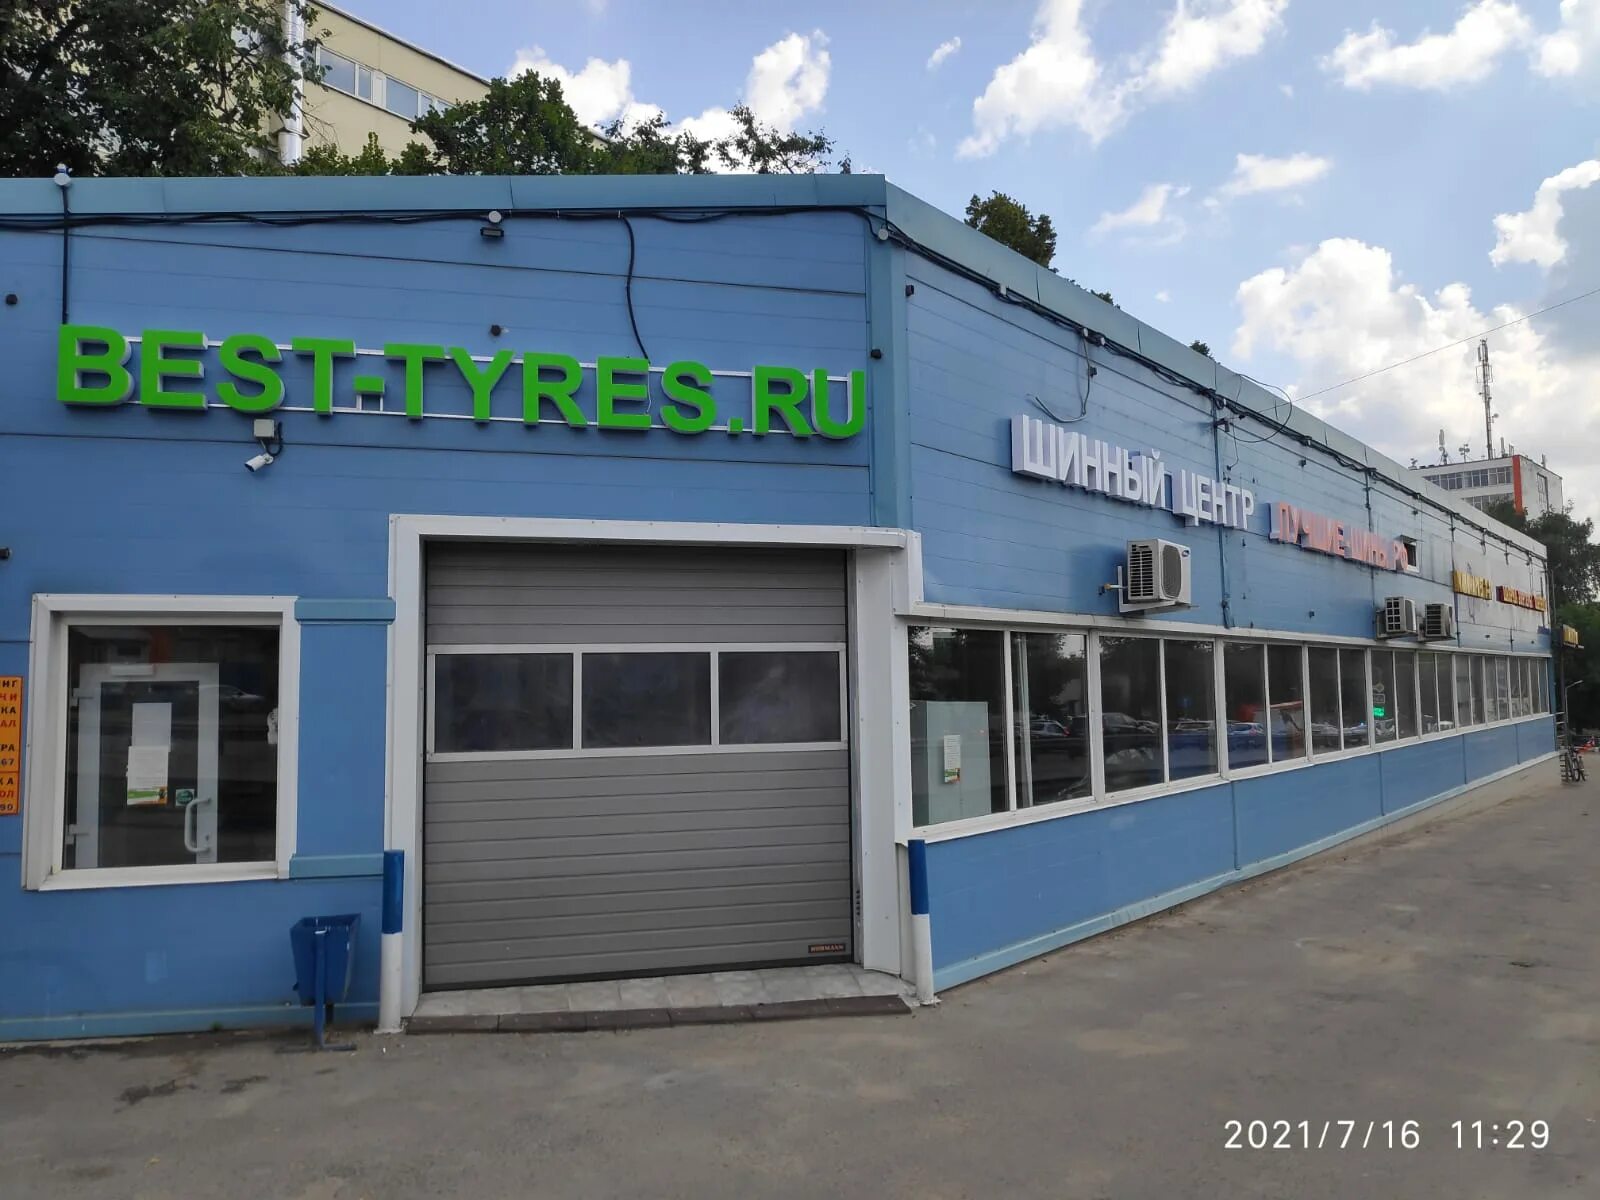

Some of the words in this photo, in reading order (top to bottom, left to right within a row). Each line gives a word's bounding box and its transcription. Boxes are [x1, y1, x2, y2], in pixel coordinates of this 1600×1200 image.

[57, 324, 867, 440] BEST-TYRES.RU
[1011, 414, 1167, 509] ШИННЫЙ
[1172, 468, 1255, 530] ЦЕНТР
